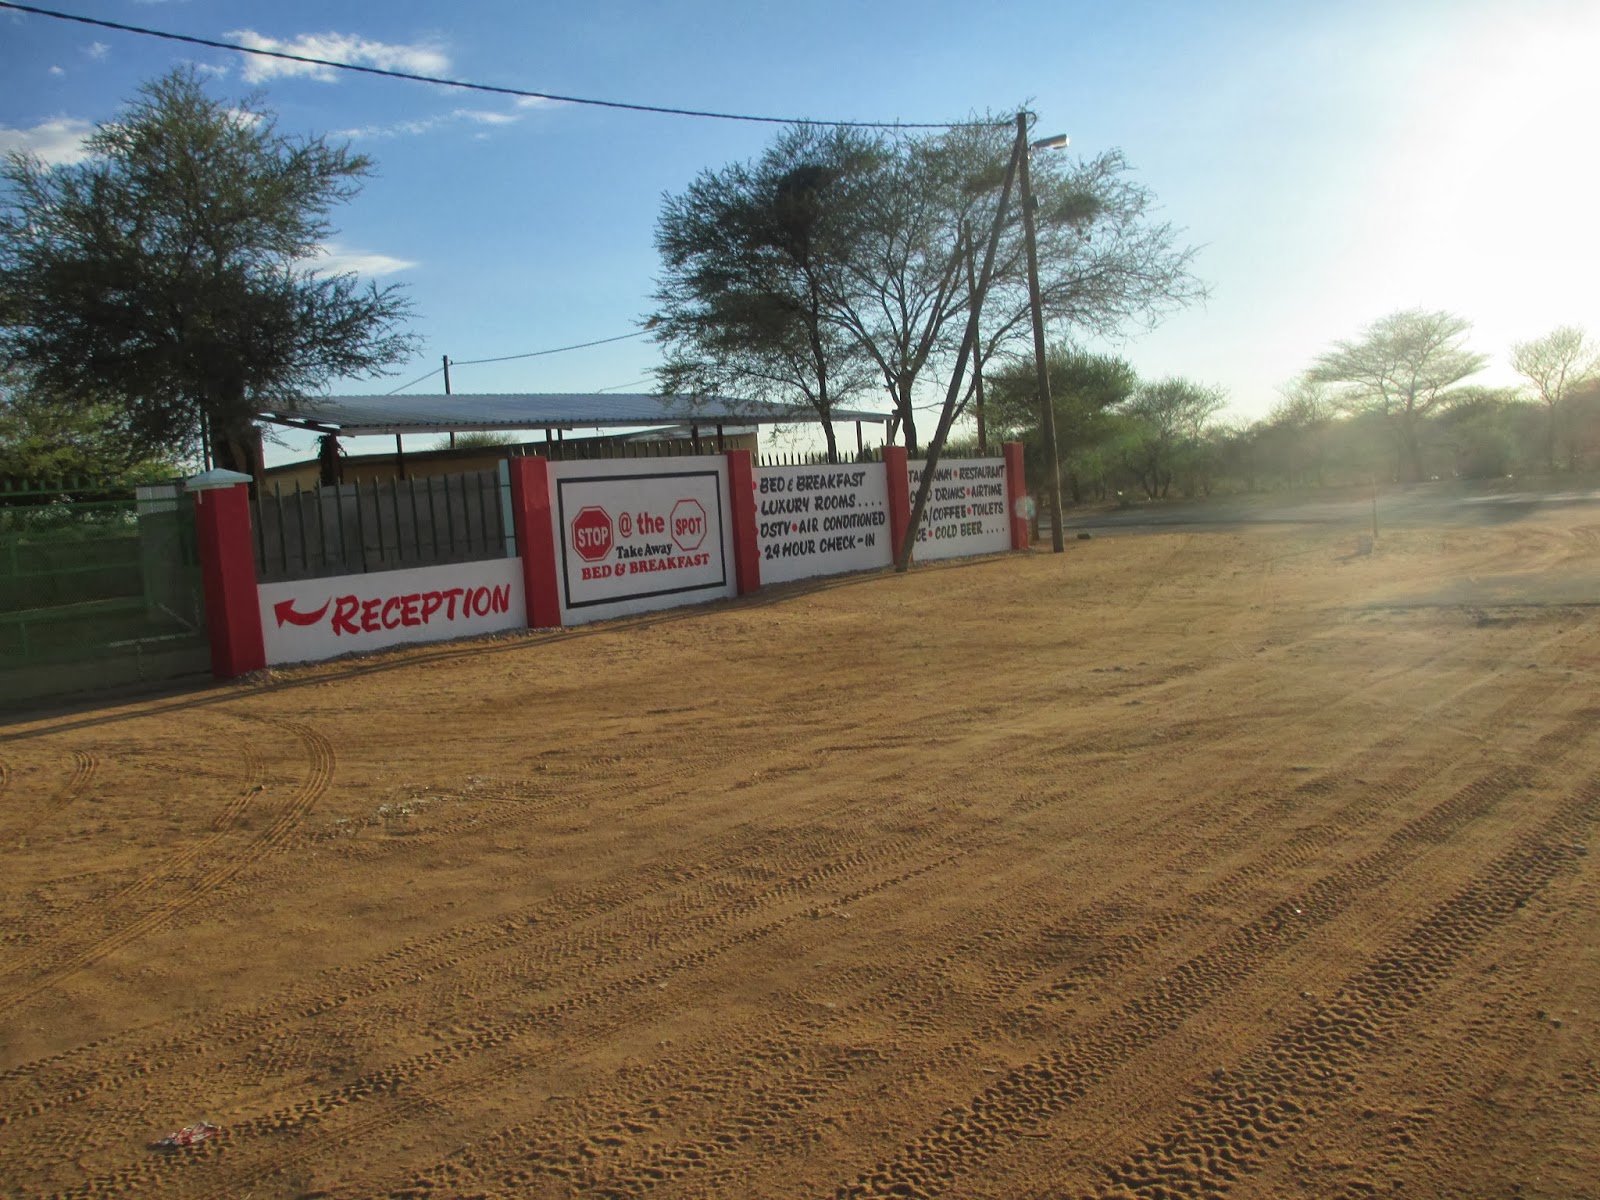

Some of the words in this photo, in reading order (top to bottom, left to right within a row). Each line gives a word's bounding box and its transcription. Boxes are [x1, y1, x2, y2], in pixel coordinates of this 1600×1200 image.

[959, 465, 1005, 480] RESTAURANT
[760, 476, 785, 494] BED
[797, 472, 866, 491] BREAKFAST
[910, 489, 932, 504] CD
[935, 486, 966, 501] DRINKS
[971, 484, 1002, 497] AIRTIME
[761, 496, 810, 516] LUXURY
[971, 502, 1004, 516] TOILETS
[577, 526, 609, 547] STOP
[618, 512, 633, 538] @
[637, 512, 665, 535] the
[675, 516, 702, 537] SPOT
[760, 521, 791, 538] DSTV
[799, 517, 818, 533] AIR
[823, 511, 885, 531] CONDITIONED
[935, 524, 957, 540] COLD
[782, 540, 816, 557] HOUR
[582, 565, 612, 580] BED
[615, 563, 626, 576] &
[630, 553, 710, 574] BREAKFAST
[331, 584, 510, 636] RECEPTION
